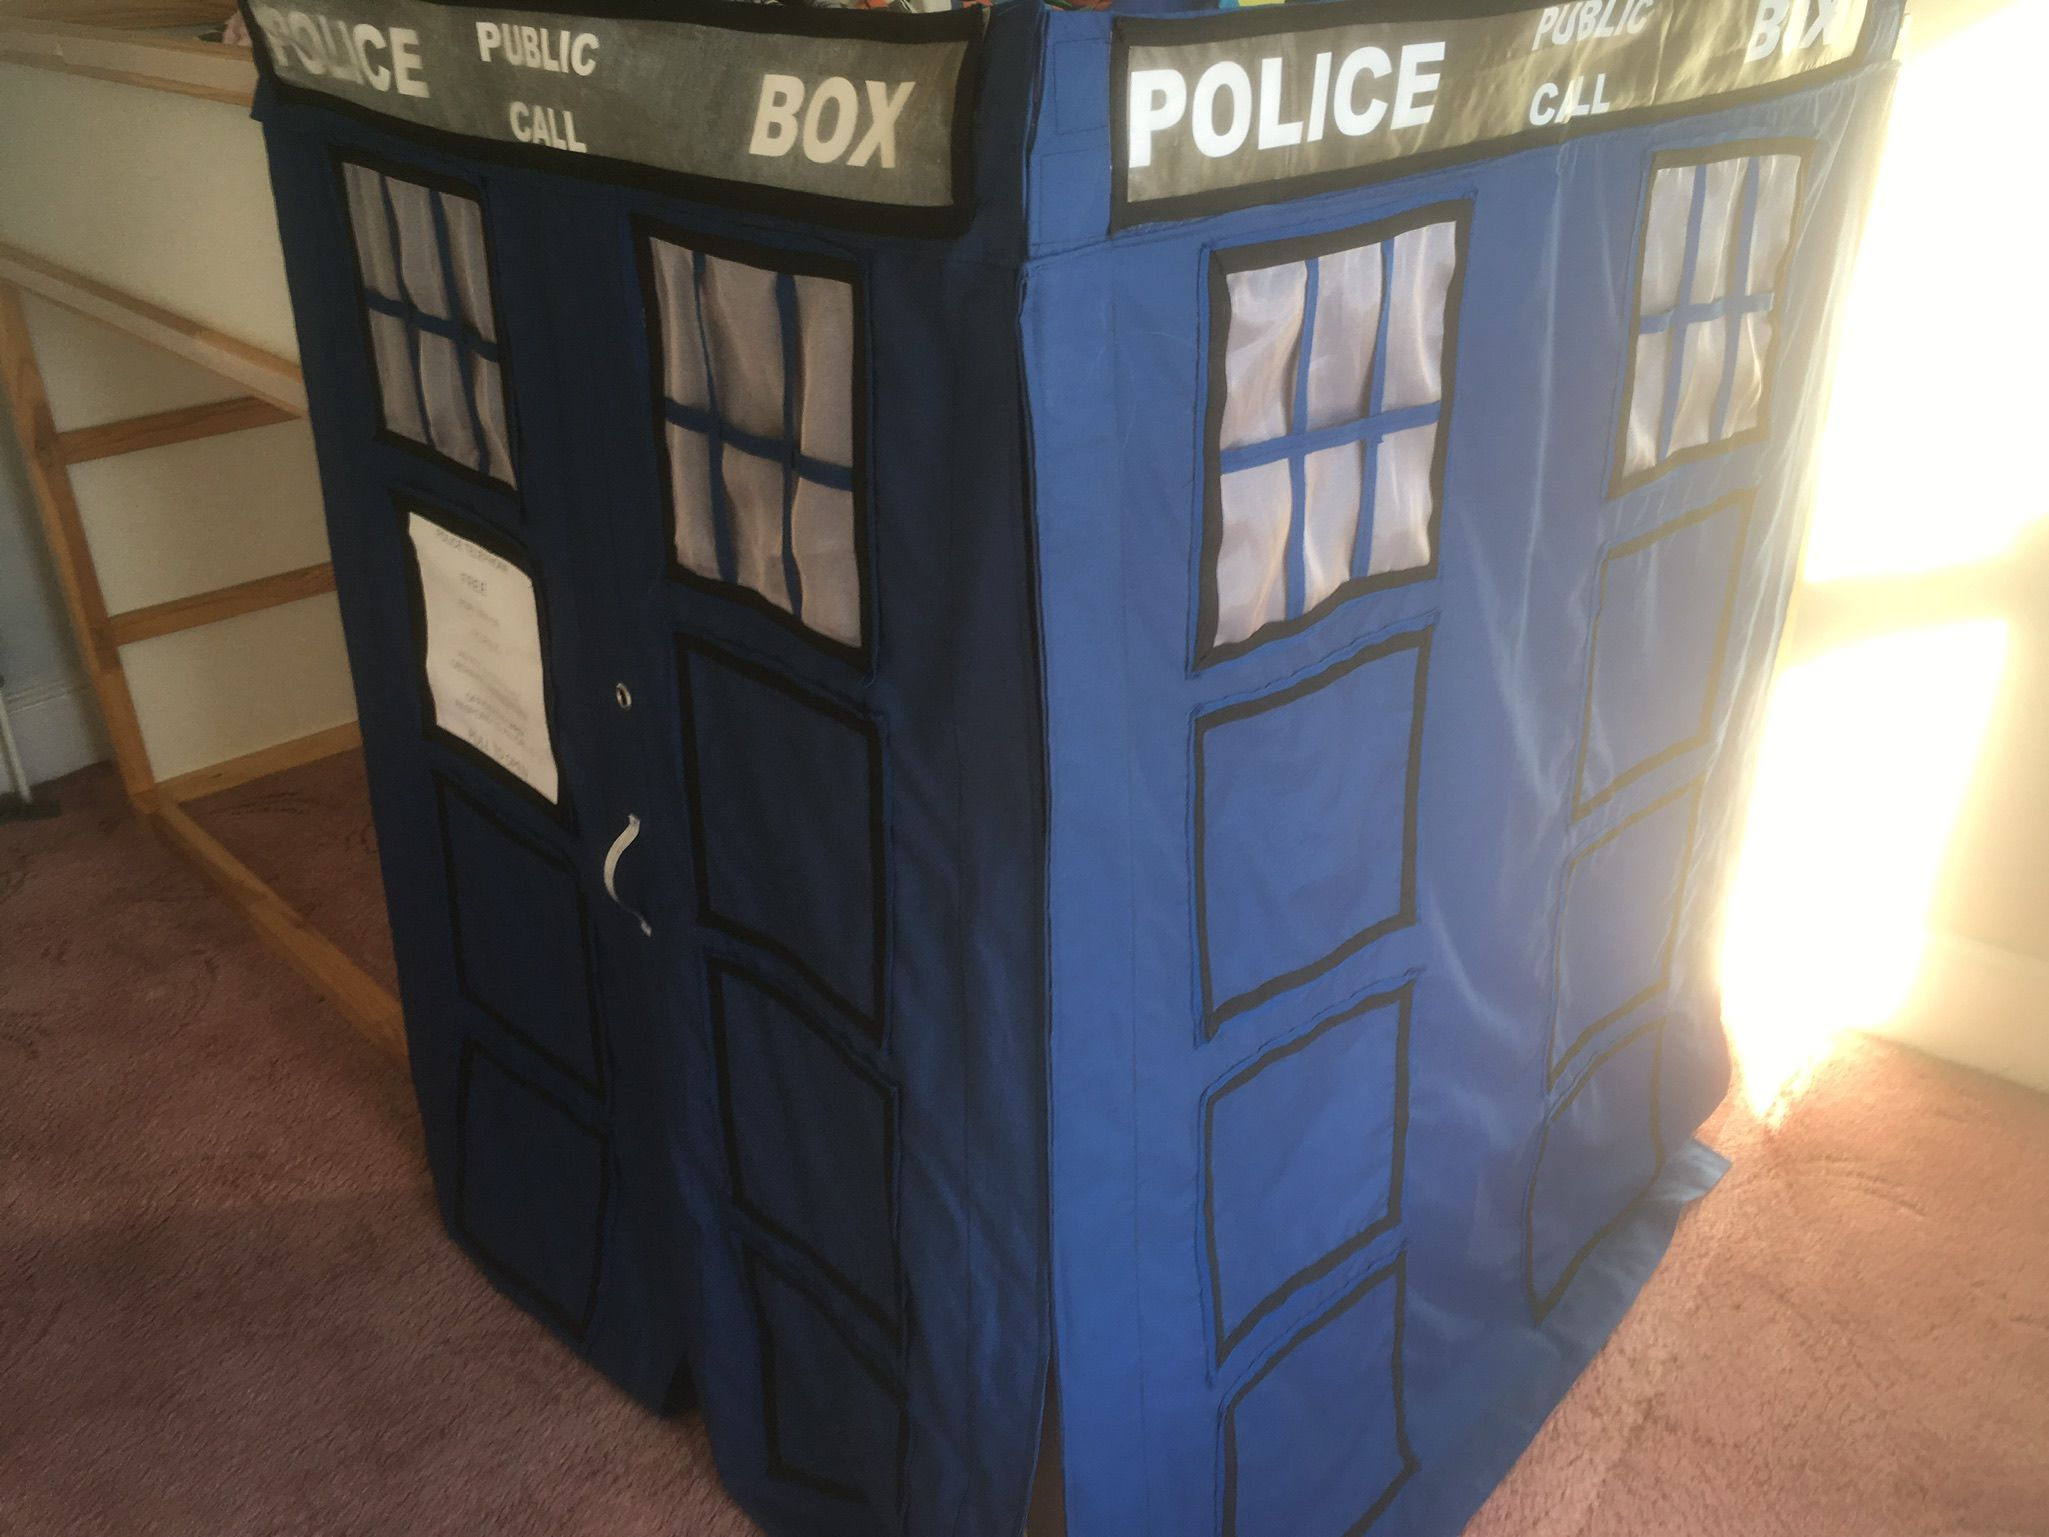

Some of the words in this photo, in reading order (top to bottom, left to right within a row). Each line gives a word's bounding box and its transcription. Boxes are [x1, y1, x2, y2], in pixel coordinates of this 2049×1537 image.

[253, 6, 430, 98] POLICE
[475, 22, 598, 77] PUBLIC
[1531, 0, 1655, 51] PUBLIC
[749, 74, 916, 169] BOX
[1129, 41, 1446, 168] POLICE
[1529, 73, 1610, 125] CALL
[509, 101, 588, 153] CALL
